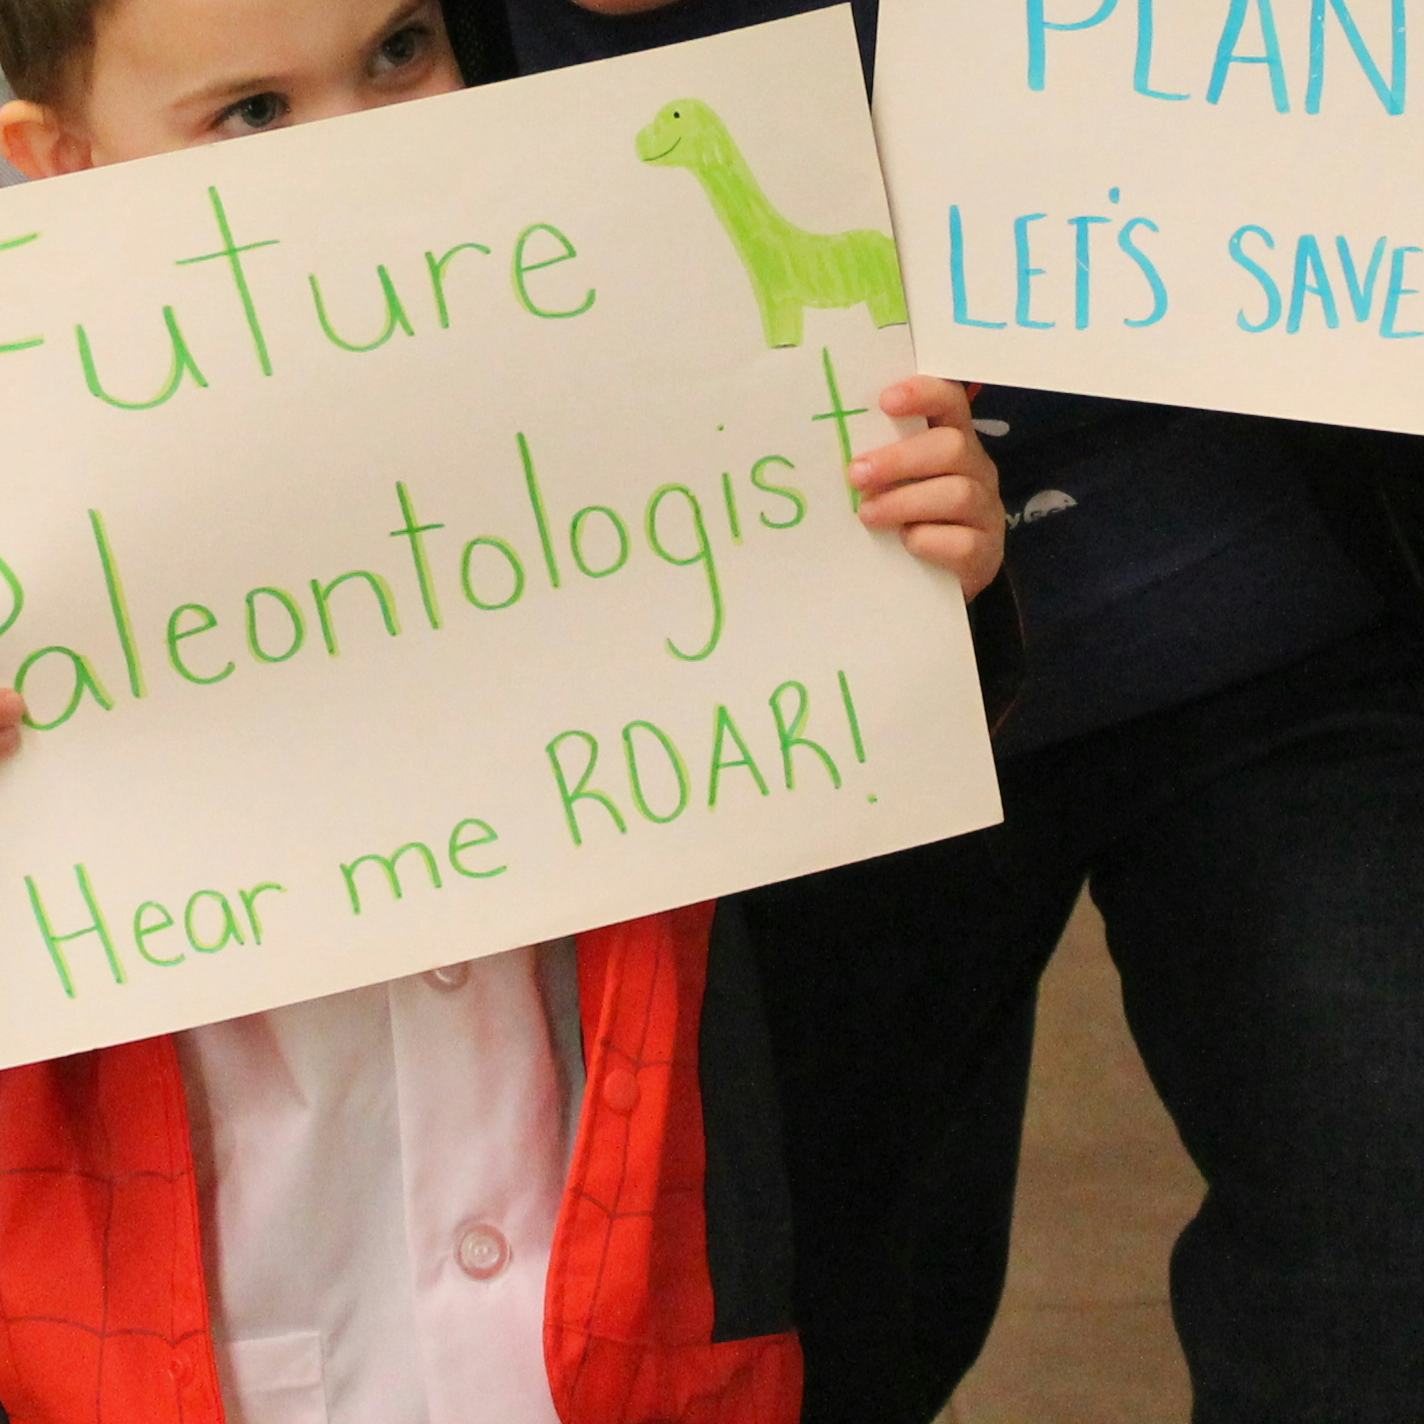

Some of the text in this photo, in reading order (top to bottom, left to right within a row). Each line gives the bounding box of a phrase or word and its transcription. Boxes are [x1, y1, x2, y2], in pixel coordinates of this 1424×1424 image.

[948, 186, 1169, 330] LET'S
[24, 668, 881, 1001] Hear me ROAR!
